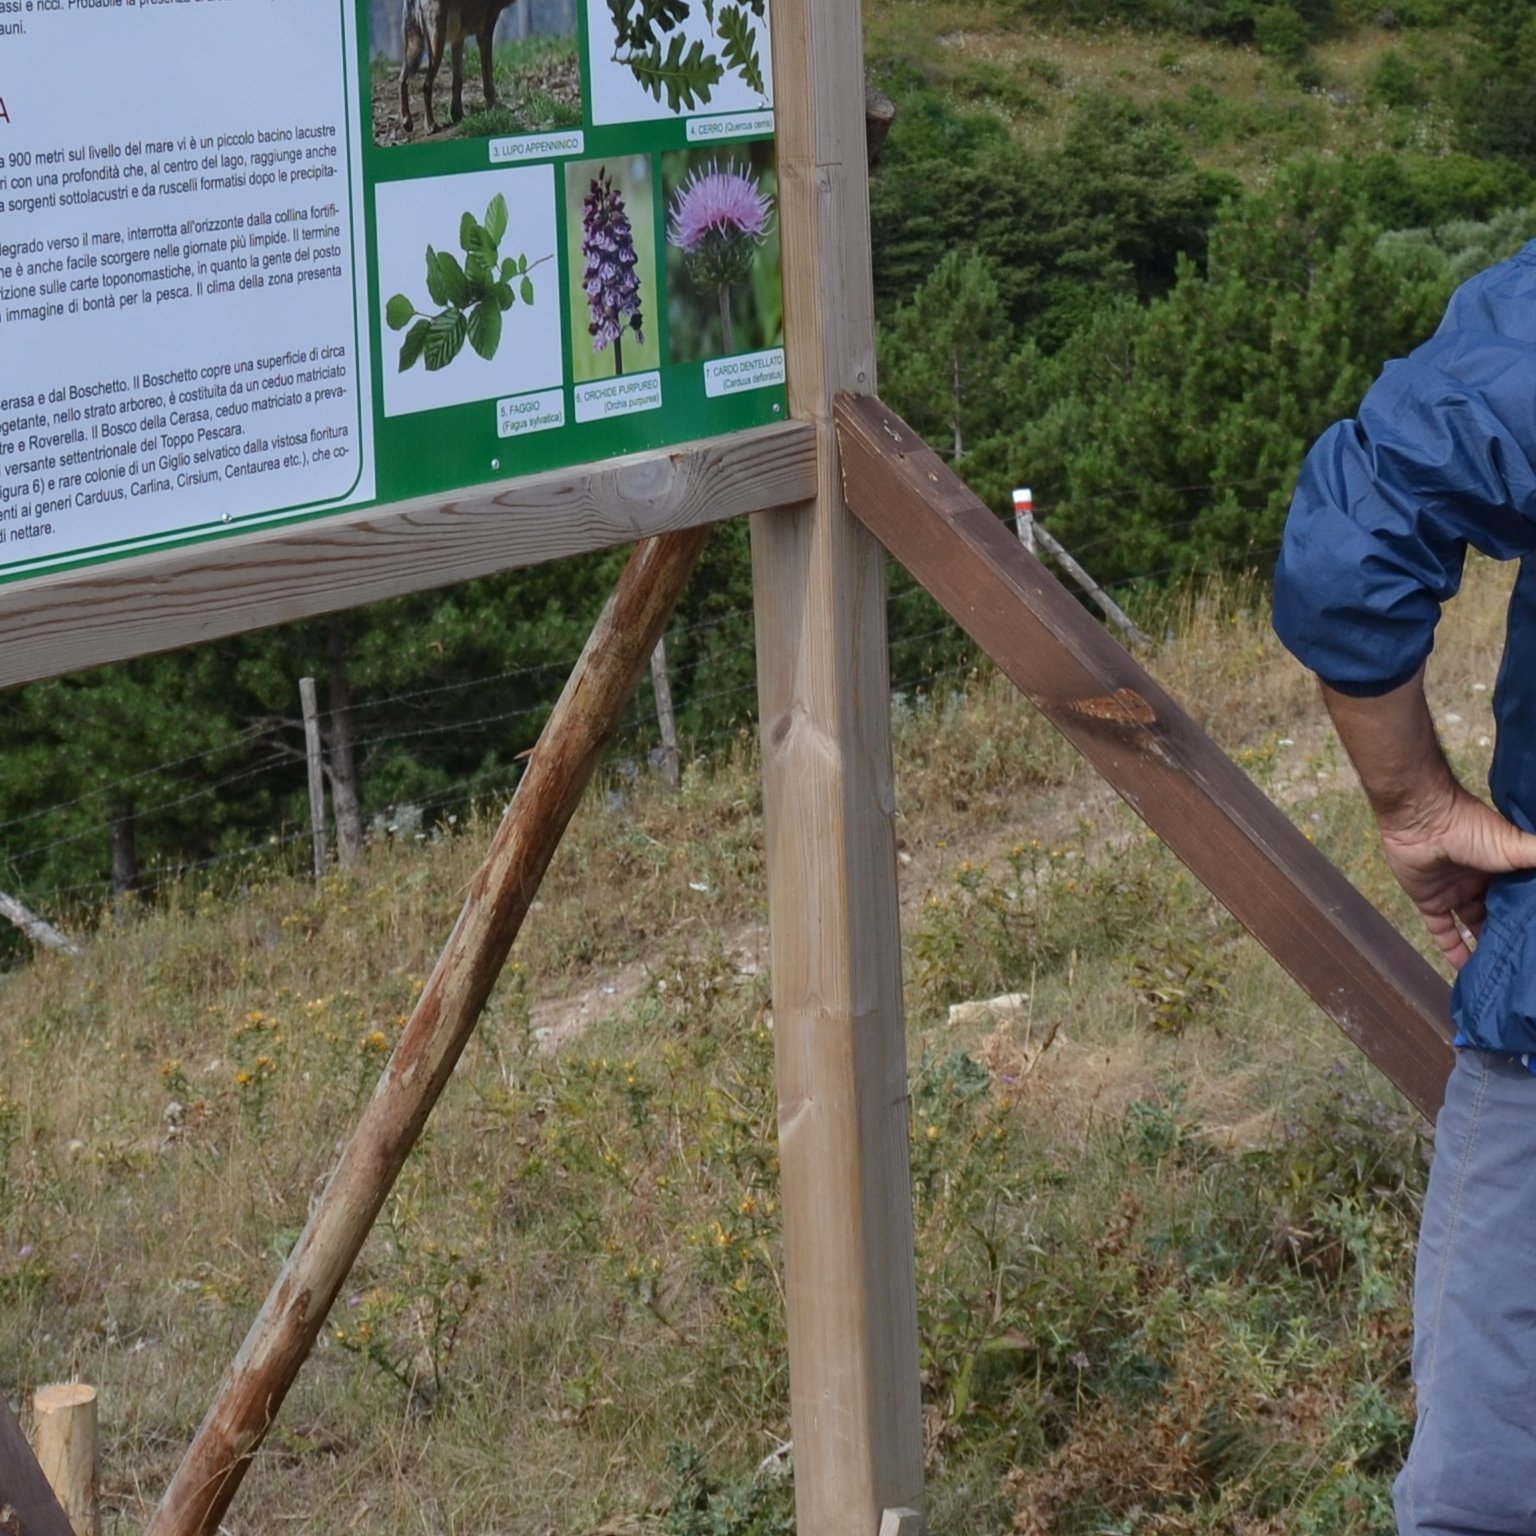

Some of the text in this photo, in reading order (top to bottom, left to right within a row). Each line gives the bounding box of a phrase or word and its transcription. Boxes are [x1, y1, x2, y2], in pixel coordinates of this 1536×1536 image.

[697, 122, 723, 135] CERRO
[502, 143, 524, 156] LUPO
[525, 137, 578, 153] APPENNINICO
[713, 362, 739, 377] CARDO
[739, 354, 783, 372] DENTELLATO
[583, 385, 617, 401] ORCHIDE
[618, 378, 658, 394] PURPUREO
[509, 400, 540, 415] FAGGIO
[502, 411, 562, 433] (Fagus sylvatica)
